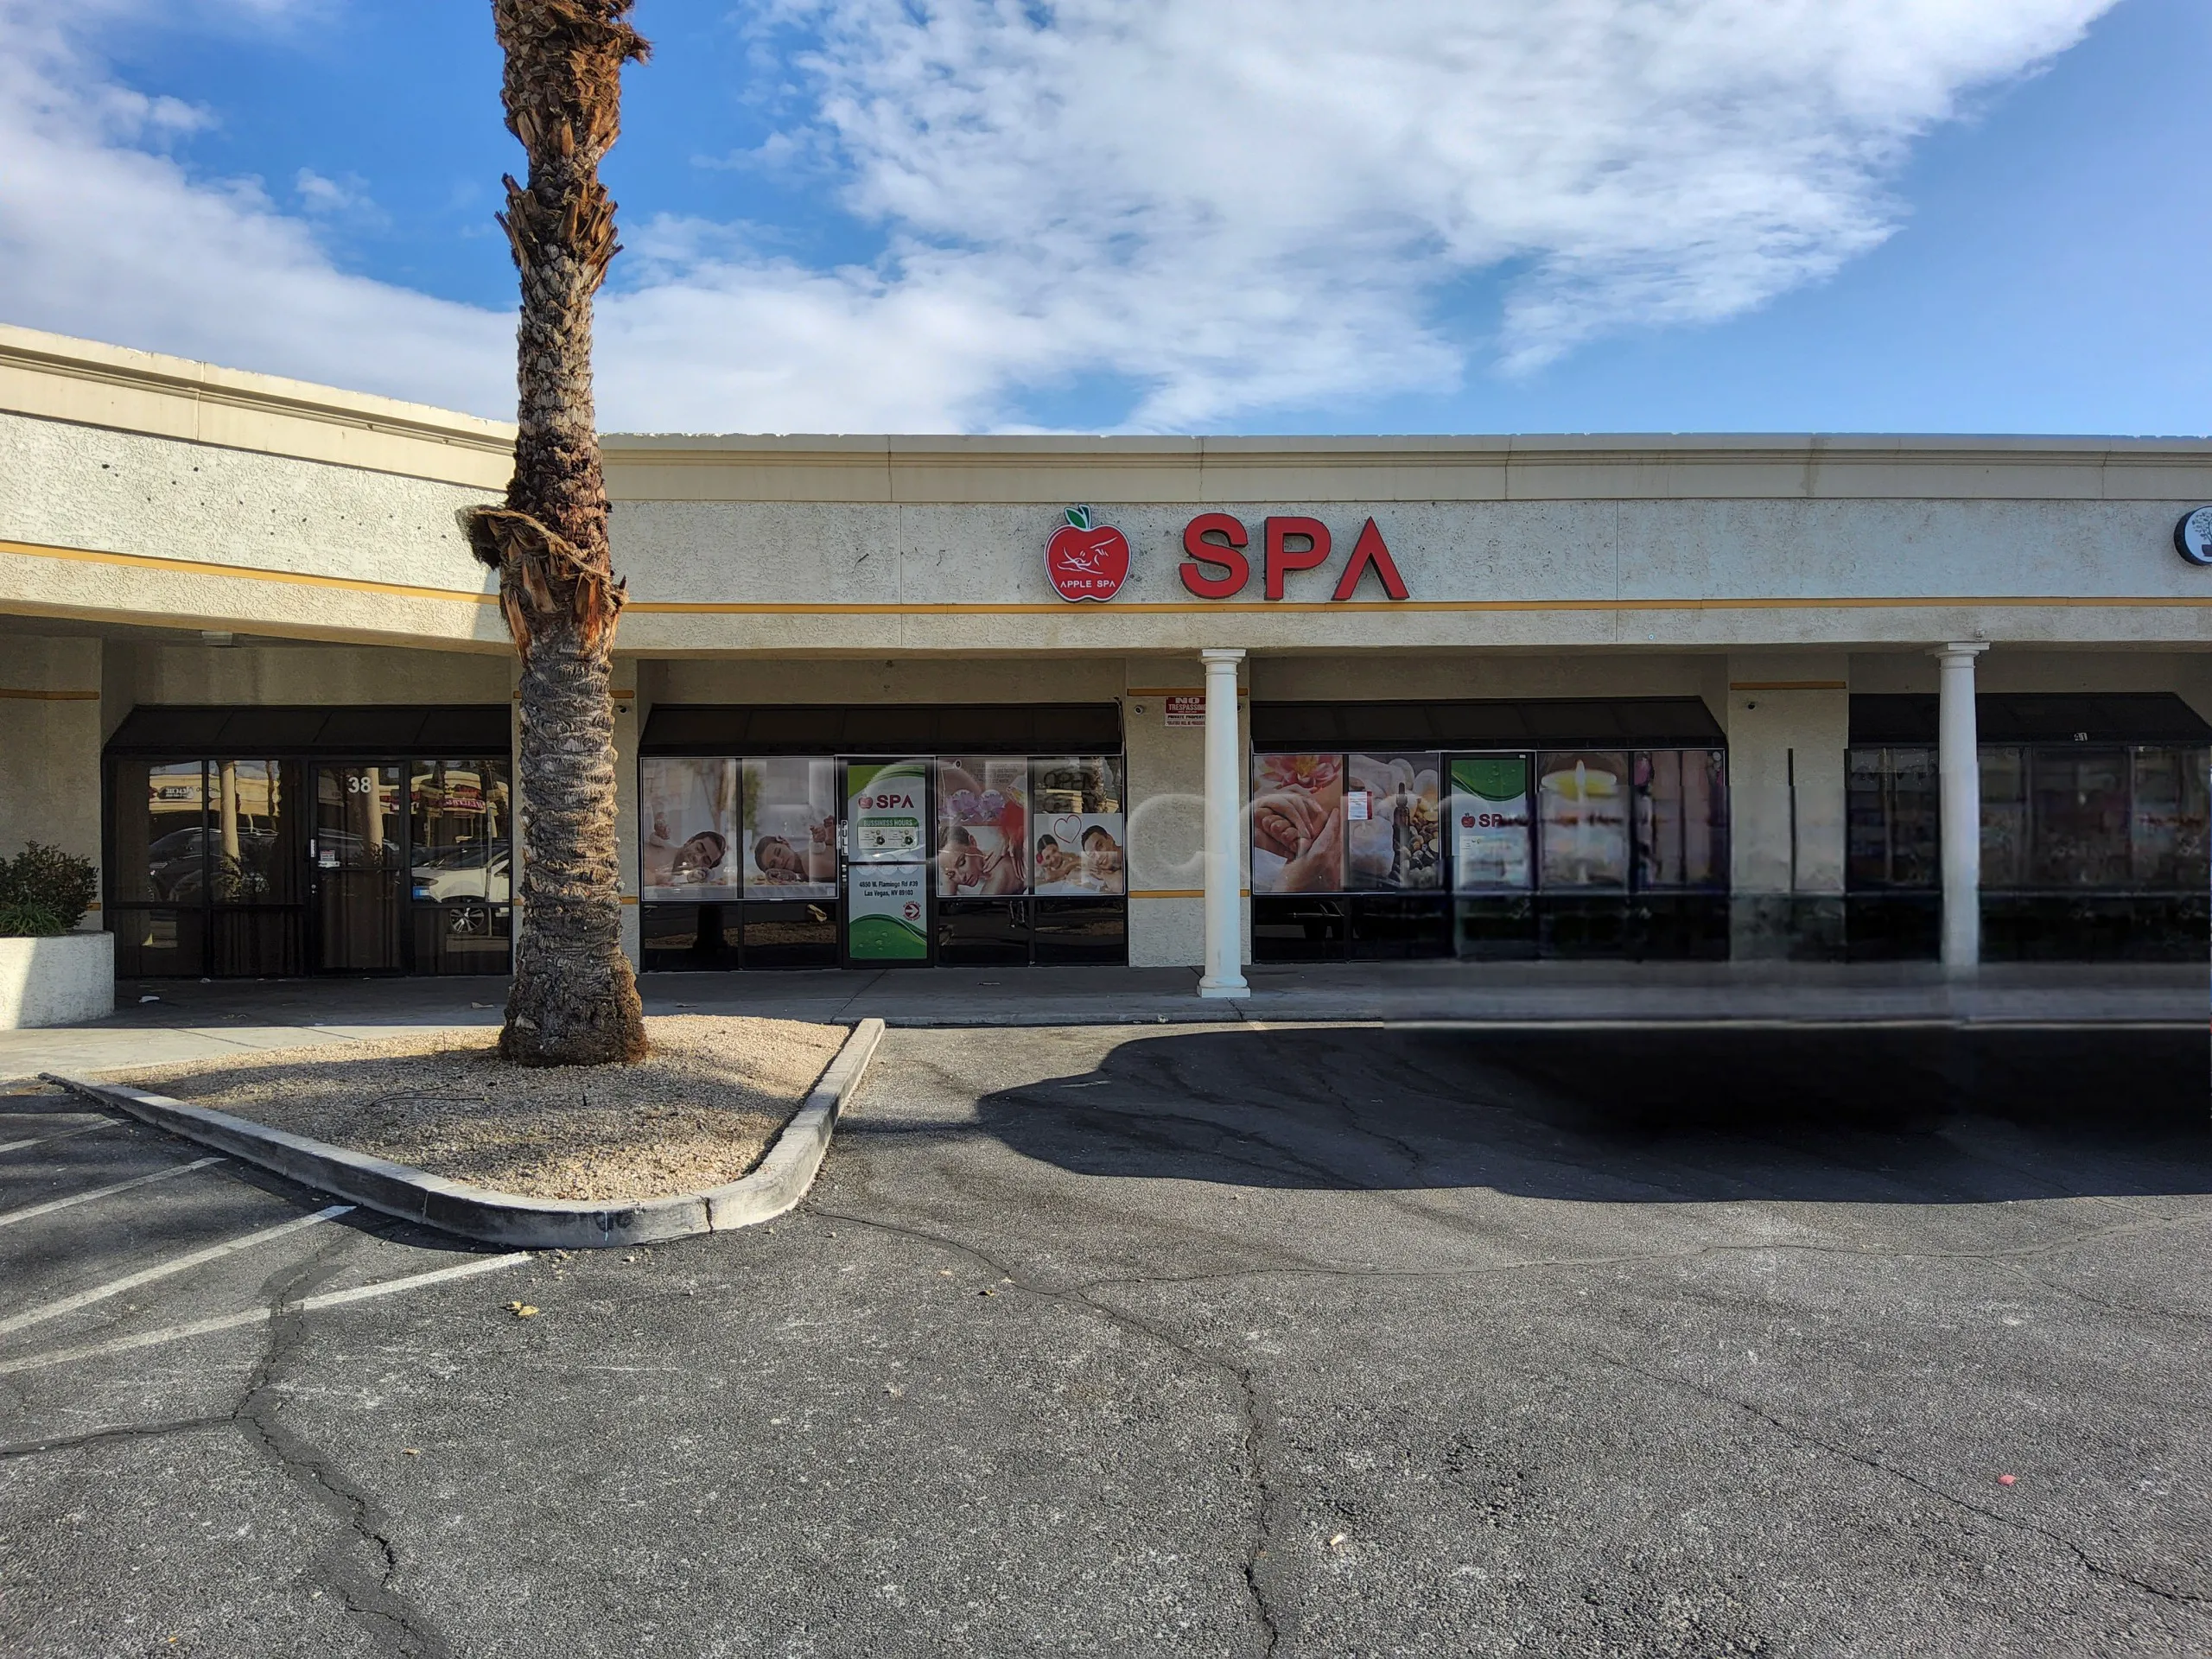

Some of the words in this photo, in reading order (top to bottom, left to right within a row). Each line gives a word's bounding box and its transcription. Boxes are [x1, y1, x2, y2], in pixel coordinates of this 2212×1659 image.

[1179, 512, 1410, 601] SPA
[347, 777, 372, 793] 38
[876, 794, 914, 809] SPA
